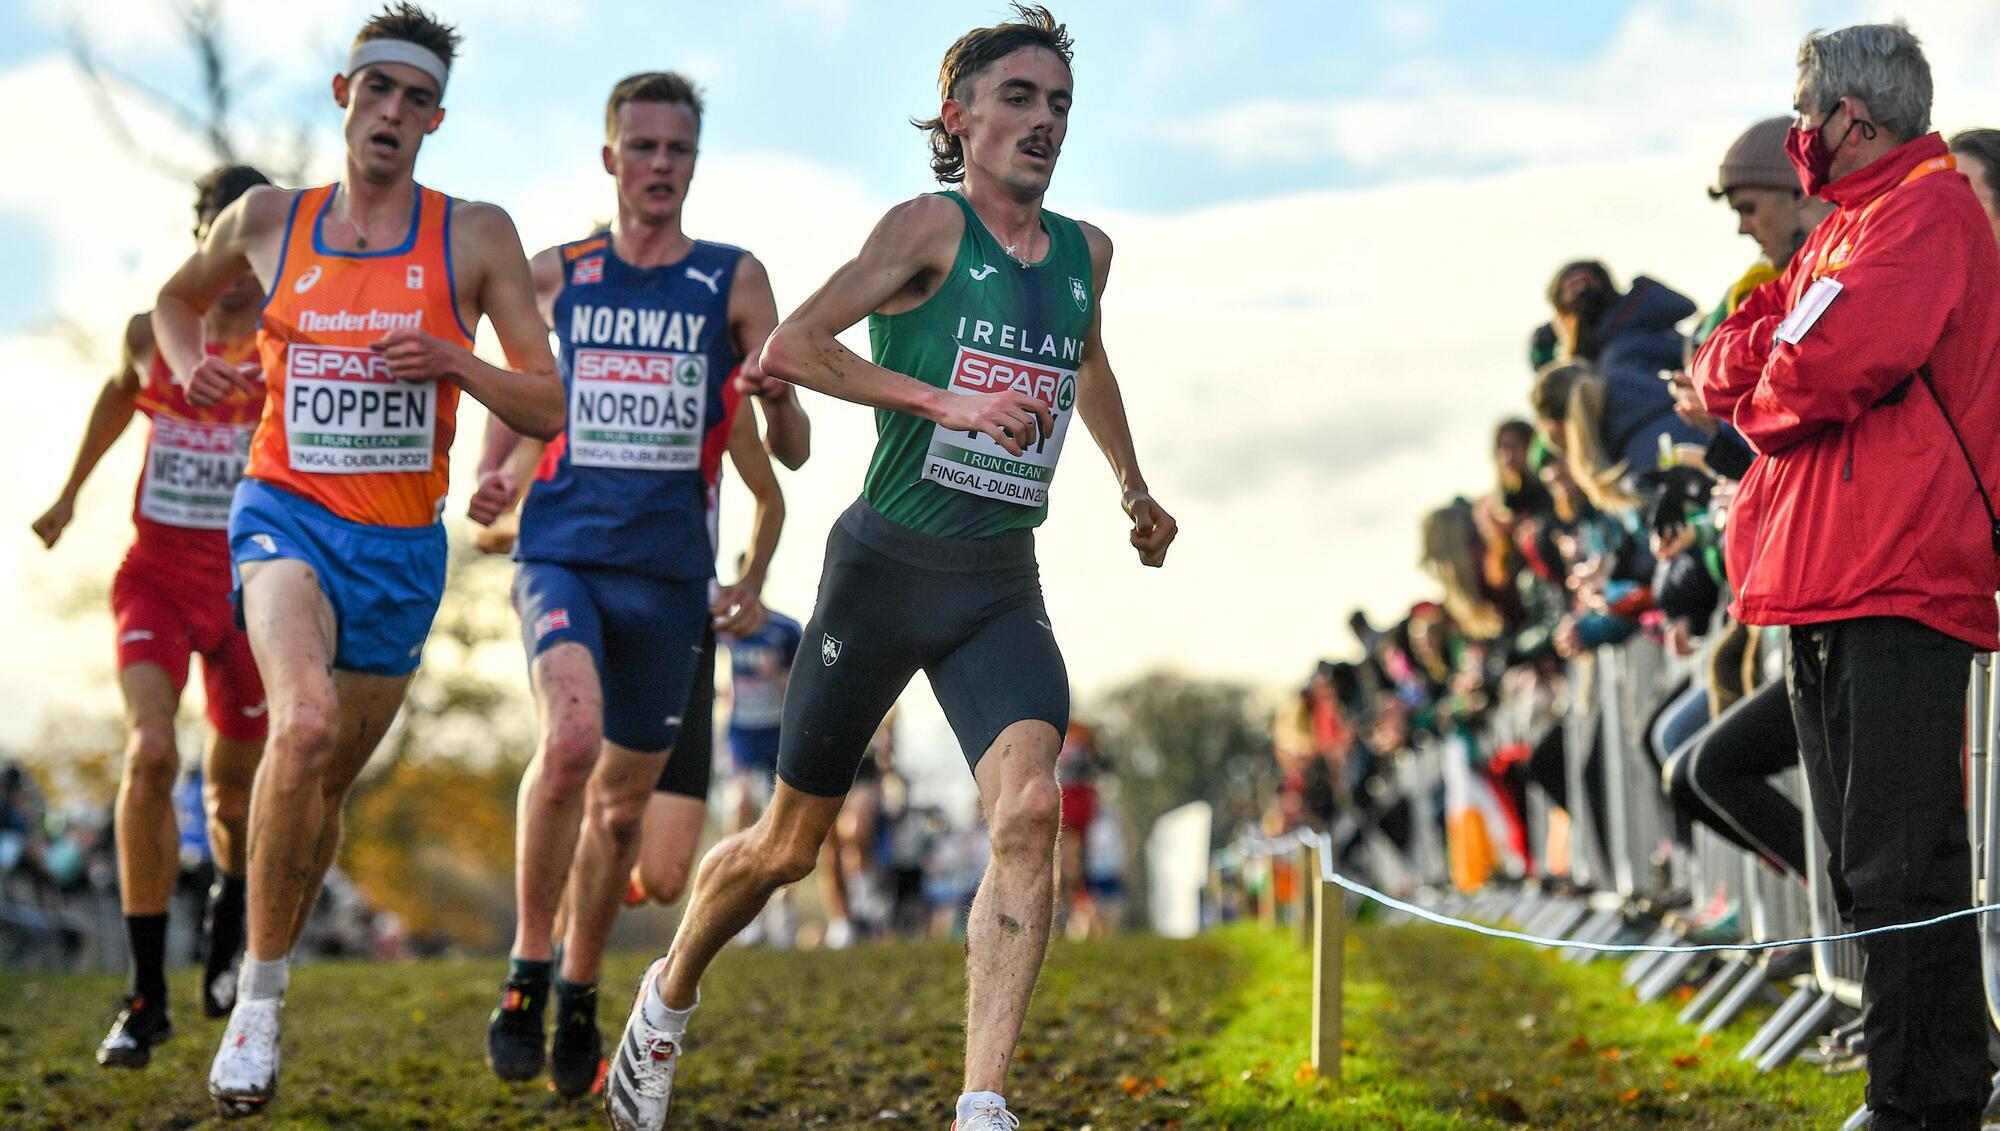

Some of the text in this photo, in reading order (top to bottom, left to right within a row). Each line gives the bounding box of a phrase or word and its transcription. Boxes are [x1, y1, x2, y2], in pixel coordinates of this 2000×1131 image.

[298, 309, 423, 332] Nederland
[571, 305, 706, 351] NORWAY
[293, 351, 395, 379] SPAR
[581, 356, 670, 381] SPAR
[959, 358, 1056, 401] SPAR
[291, 386, 427, 427] FOPPEN
[576, 391, 698, 429] NORDÅS
[155, 419, 232, 451] SPAR
[322, 435, 352, 447] RUN
[354, 436, 400, 448] CLEAN
[155, 452, 245, 489] MECHAA
[294, 452, 427, 467] NGAL-DUBLIN 2021
[963, 451, 1042, 479] I RUN CLEAN
[929, 463, 1035, 501] FINGAL-DUBLIN
